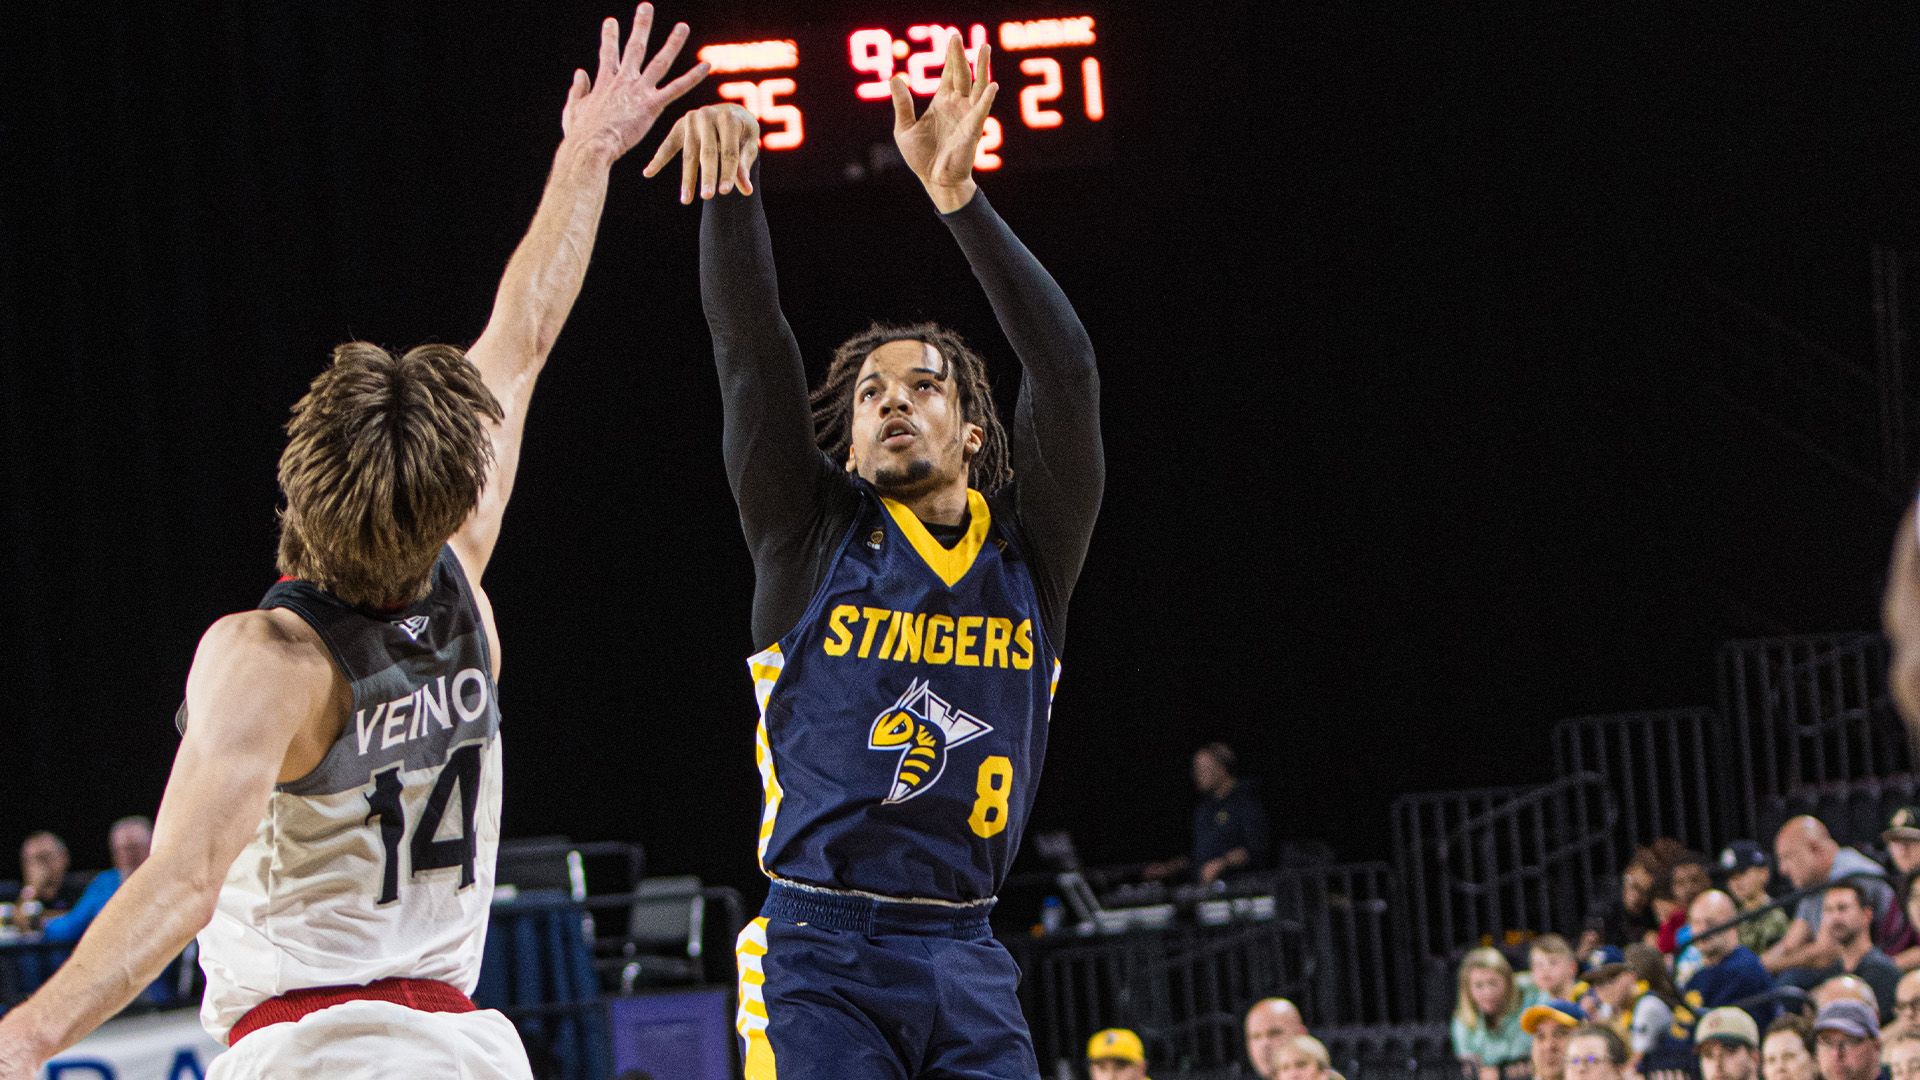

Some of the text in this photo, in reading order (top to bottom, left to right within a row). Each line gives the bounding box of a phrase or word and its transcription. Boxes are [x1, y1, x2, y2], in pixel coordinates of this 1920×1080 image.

[1020, 57, 1103, 128] 21
[974, 116, 1002, 171] 2
[823, 604, 1034, 670] STINGERS
[356, 668, 488, 756] VEINO
[363, 742, 483, 905] 14
[968, 755, 1013, 839] 8
